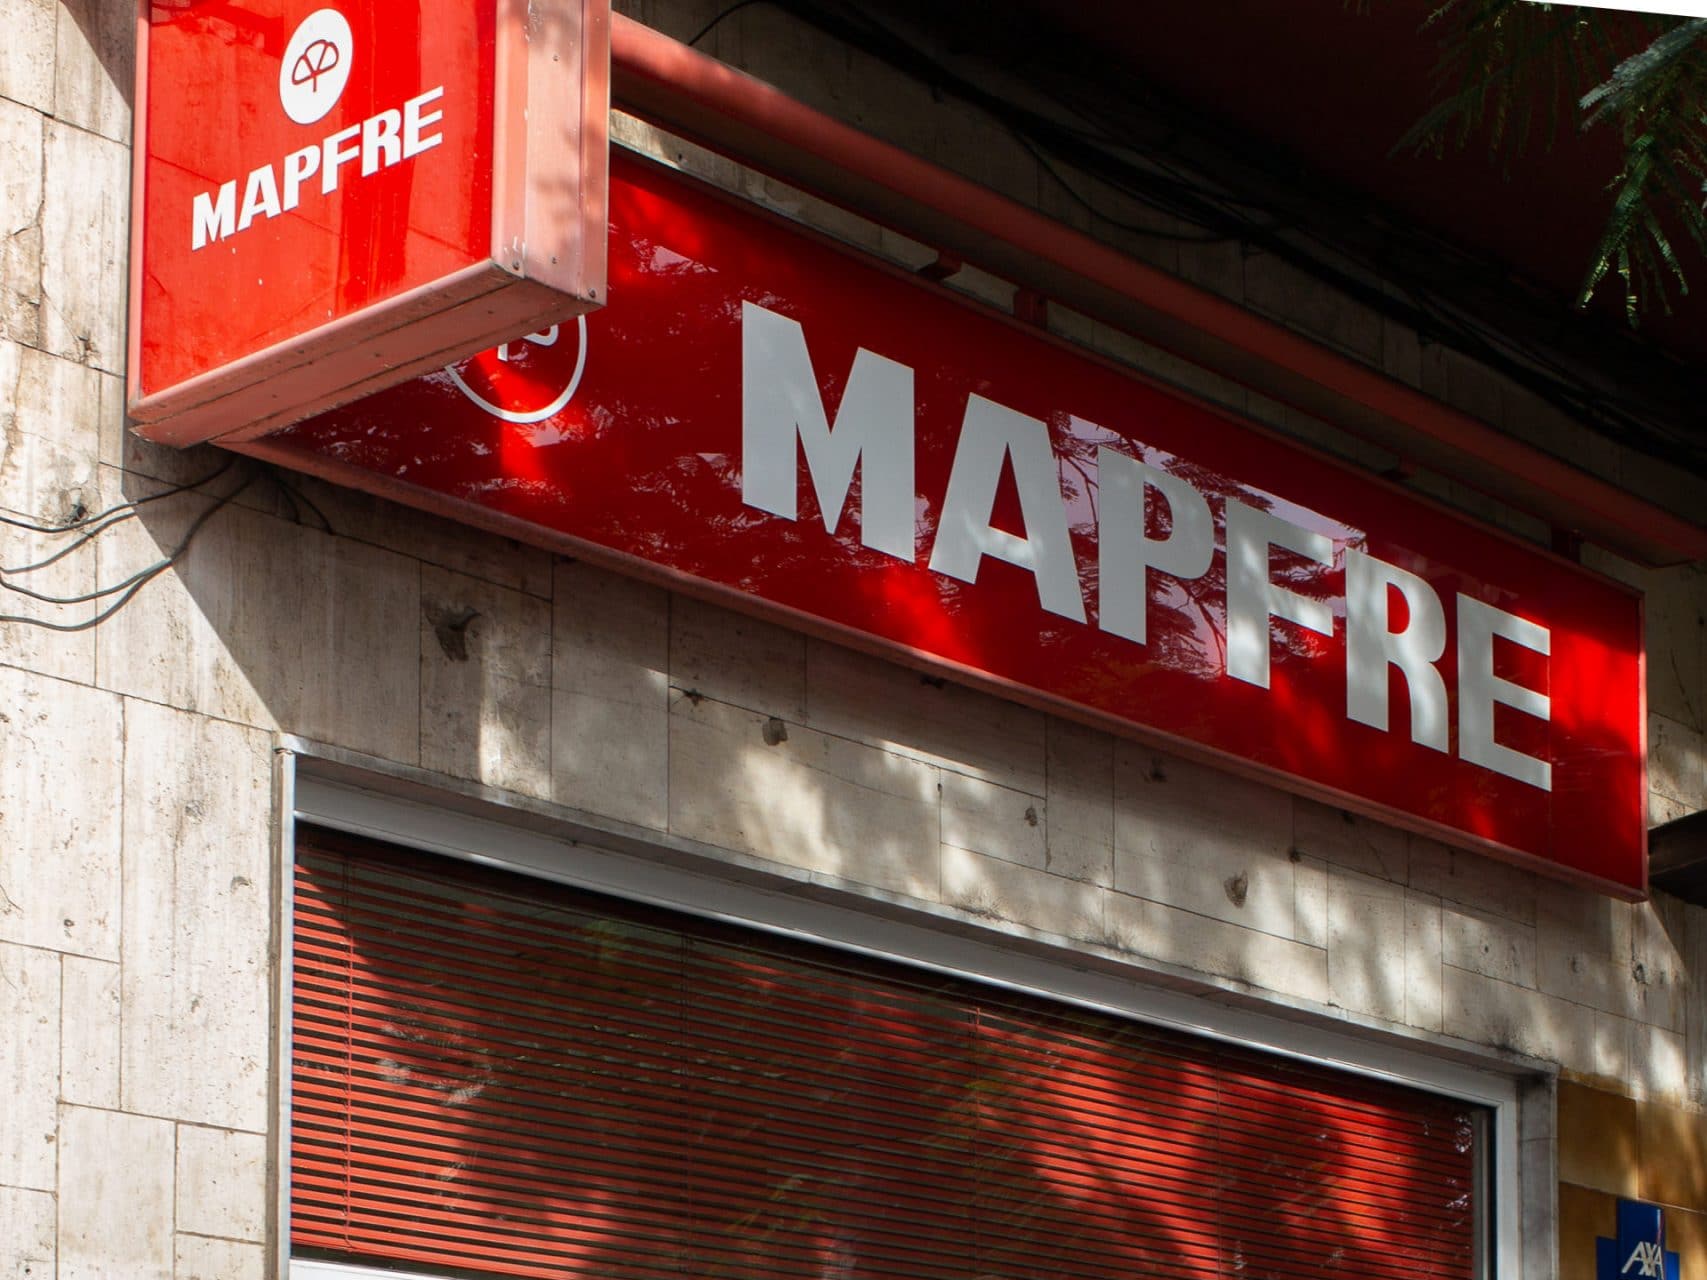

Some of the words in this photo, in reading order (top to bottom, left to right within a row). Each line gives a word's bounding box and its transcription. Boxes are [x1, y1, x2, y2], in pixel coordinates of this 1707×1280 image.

[192, 86, 444, 251] MAPFRE
[742, 300, 1553, 792] MAPFRE
[1621, 1241, 1664, 1280] AXA
